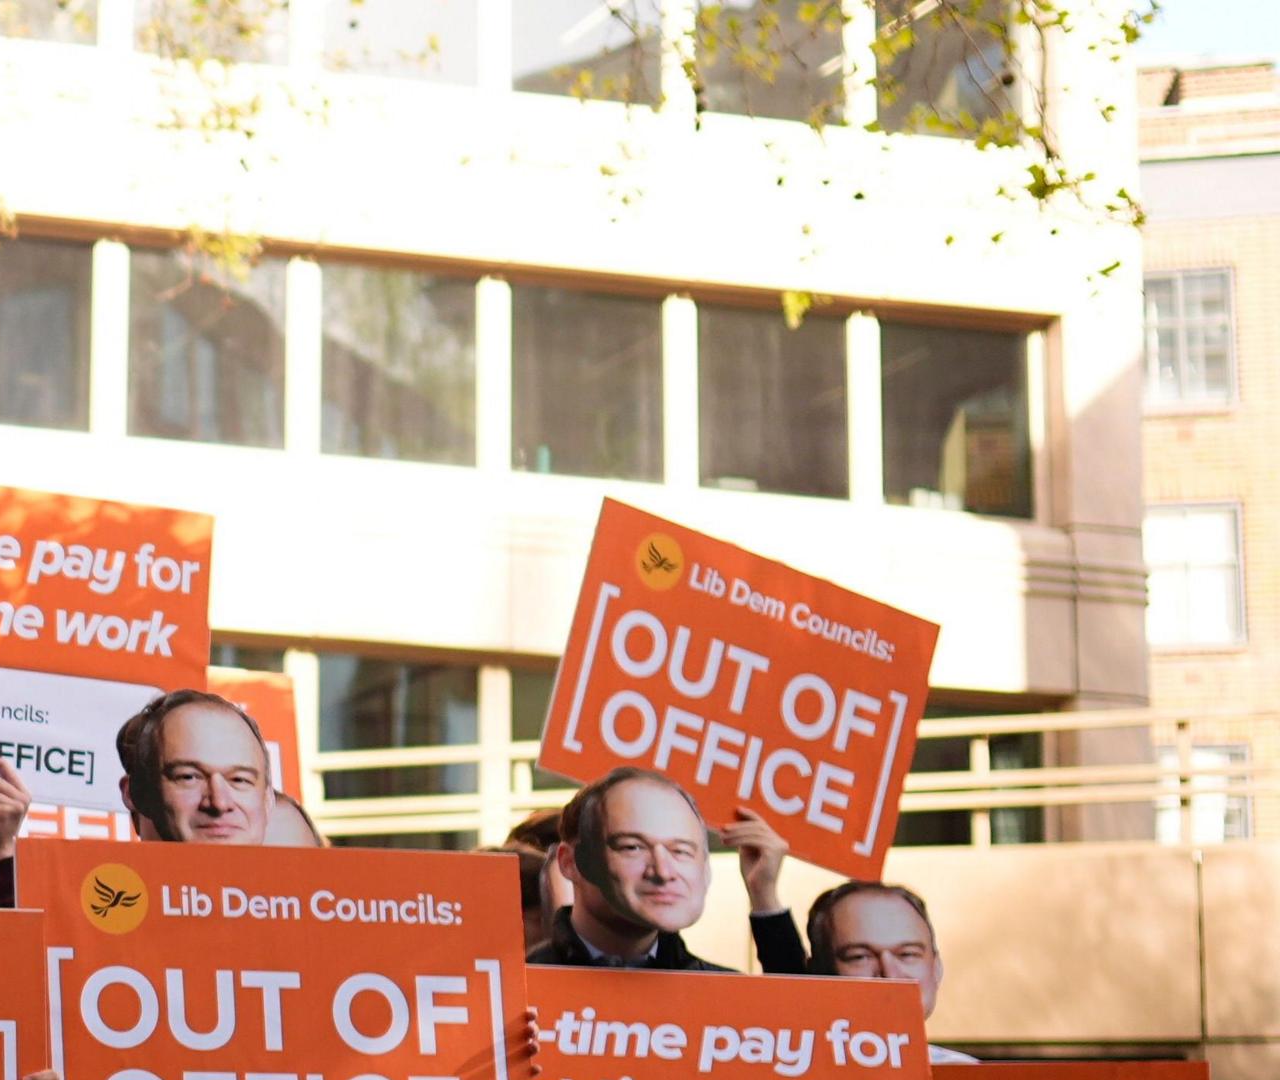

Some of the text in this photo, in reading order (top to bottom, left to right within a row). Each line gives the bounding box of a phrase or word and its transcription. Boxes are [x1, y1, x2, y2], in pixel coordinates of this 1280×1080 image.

[28, 539, 124, 594] pay
[135, 544, 200, 593] for
[56, 610, 179, 658] work
[689, 563, 895, 662] Lib Dem Councils:
[161, 885, 463, 926] Lib Dem Councils:
[698, 1022, 814, 1077] pay
[826, 1019, 909, 1069] for
